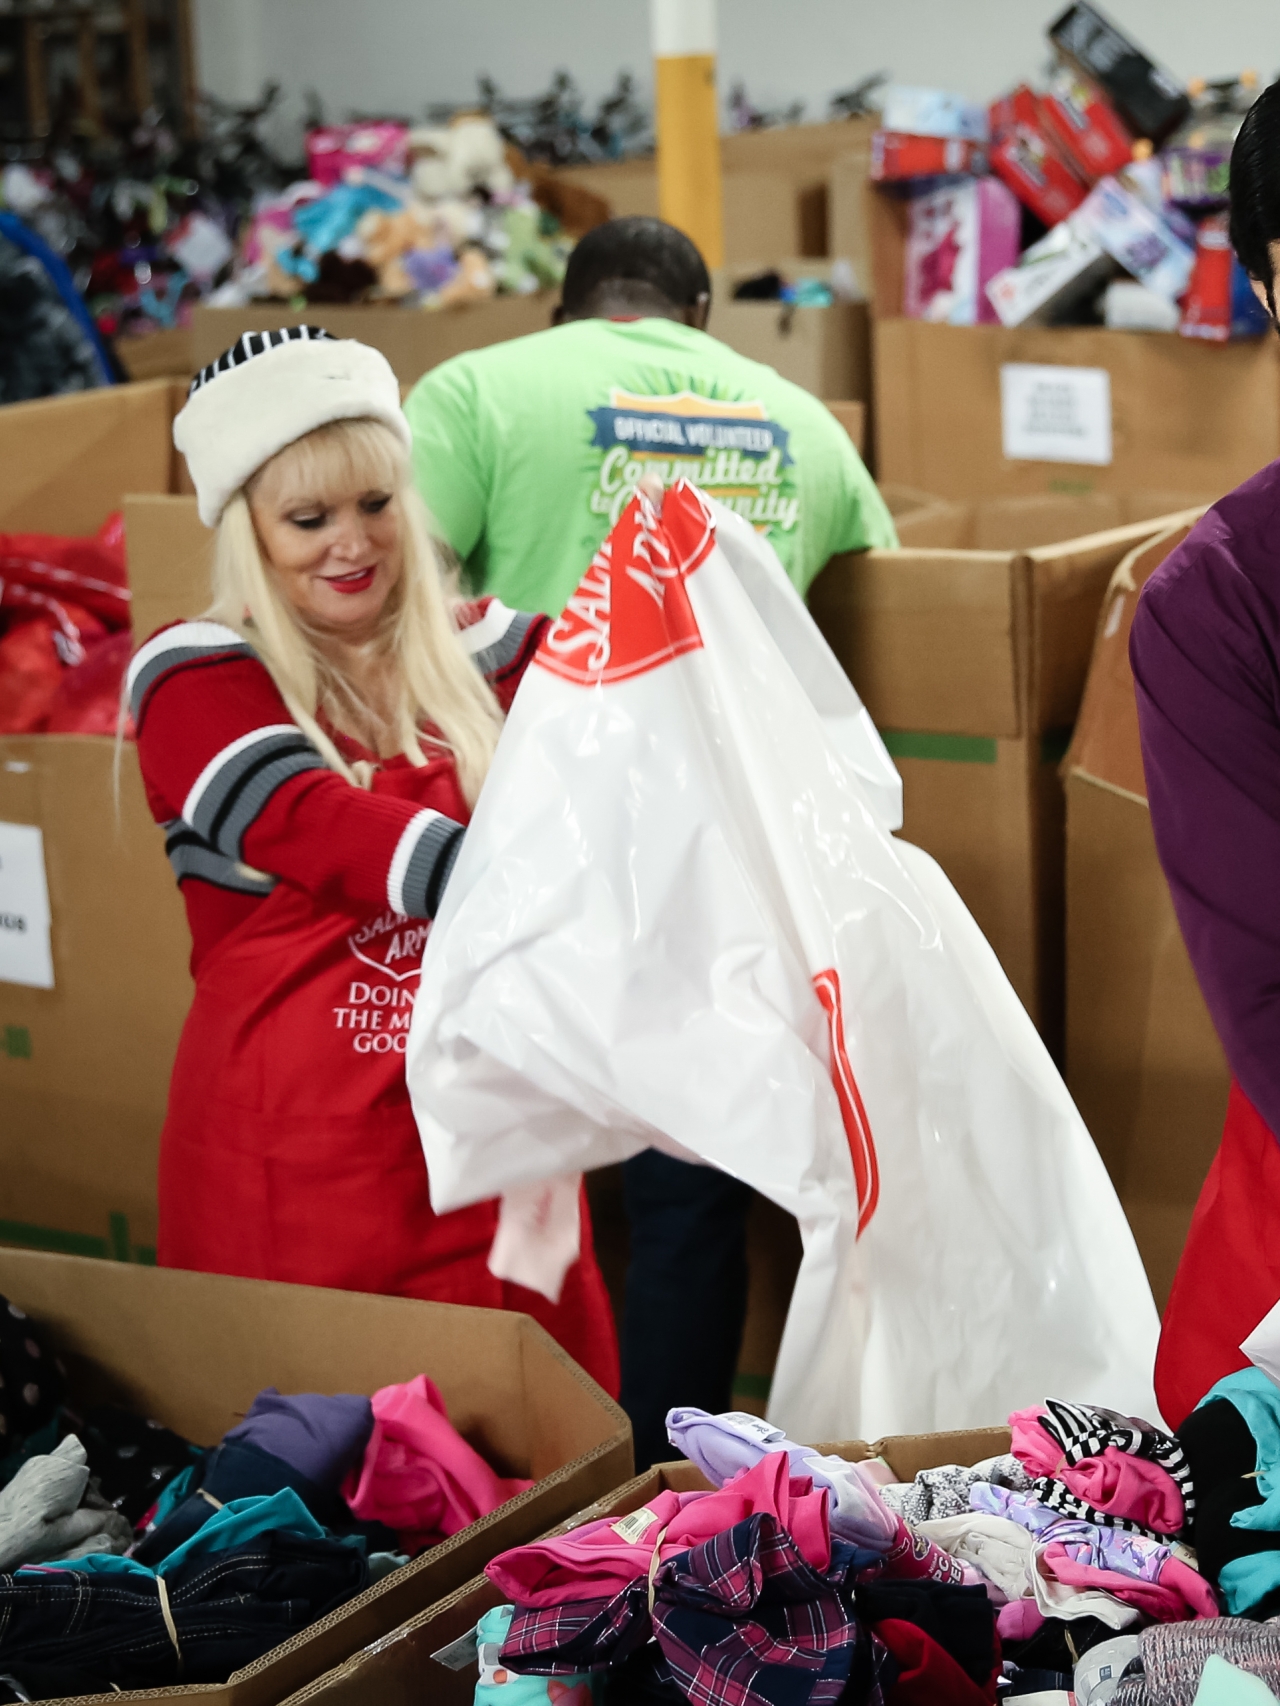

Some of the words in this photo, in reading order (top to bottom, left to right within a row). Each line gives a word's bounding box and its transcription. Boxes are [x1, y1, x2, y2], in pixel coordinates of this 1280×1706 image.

[600, 446, 782, 494] Committed
[383, 922, 433, 965] ARM
[348, 981, 417, 1007] DOIN
[332, 1007, 384, 1031] THE
[352, 1031, 409, 1054] GOO
